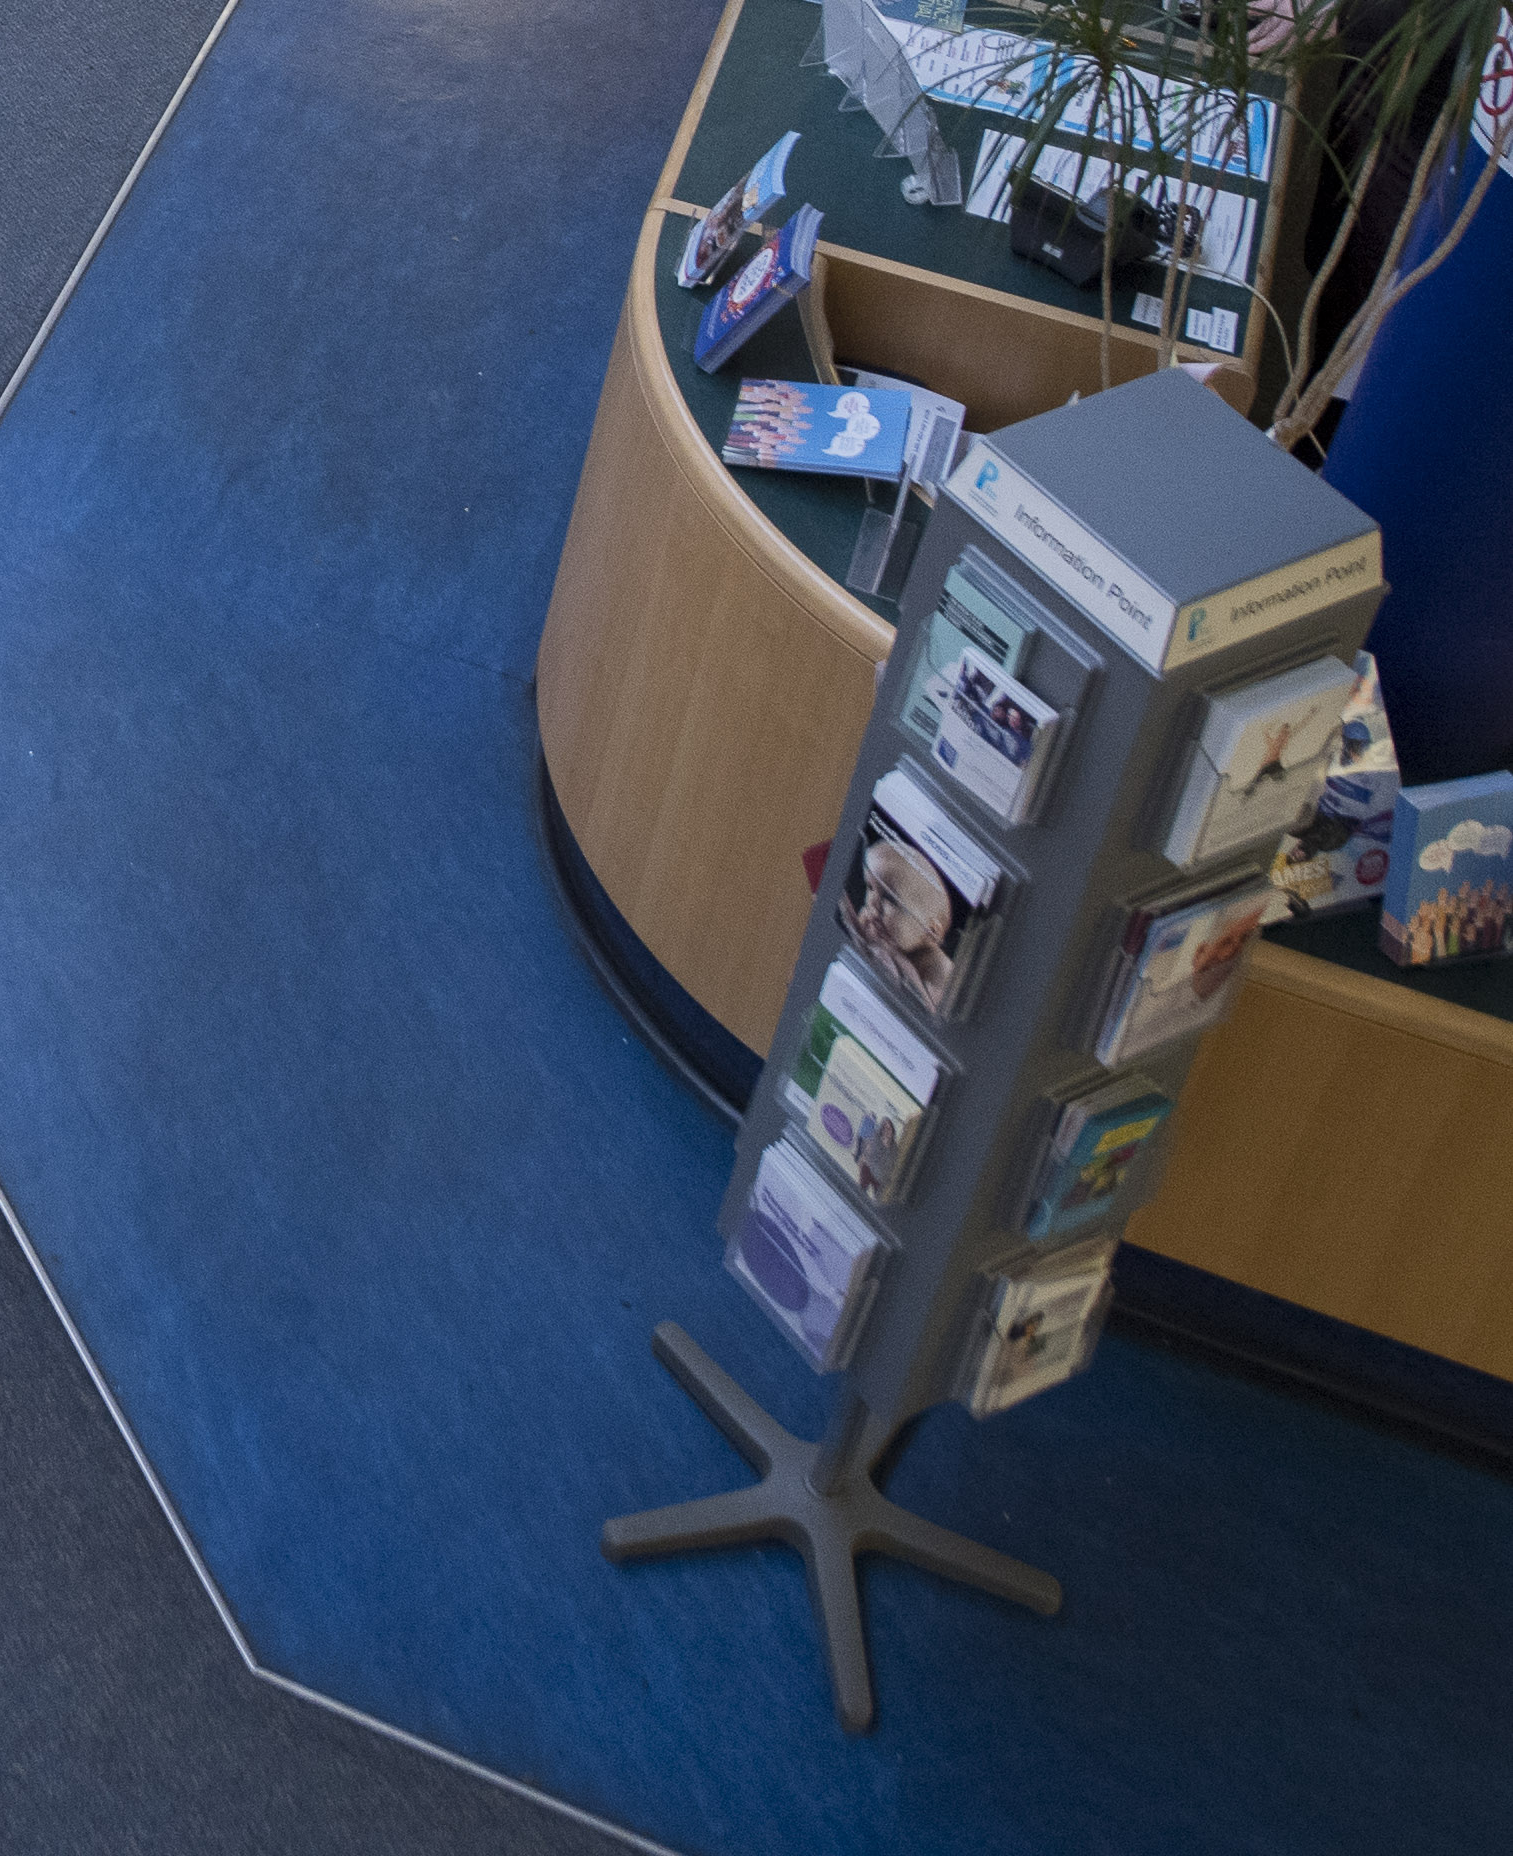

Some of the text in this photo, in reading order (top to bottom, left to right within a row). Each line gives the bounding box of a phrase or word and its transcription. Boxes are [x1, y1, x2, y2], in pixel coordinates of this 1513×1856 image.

[1013, 502, 1154, 632] Information Point
[1229, 555, 1368, 625] Information Point
